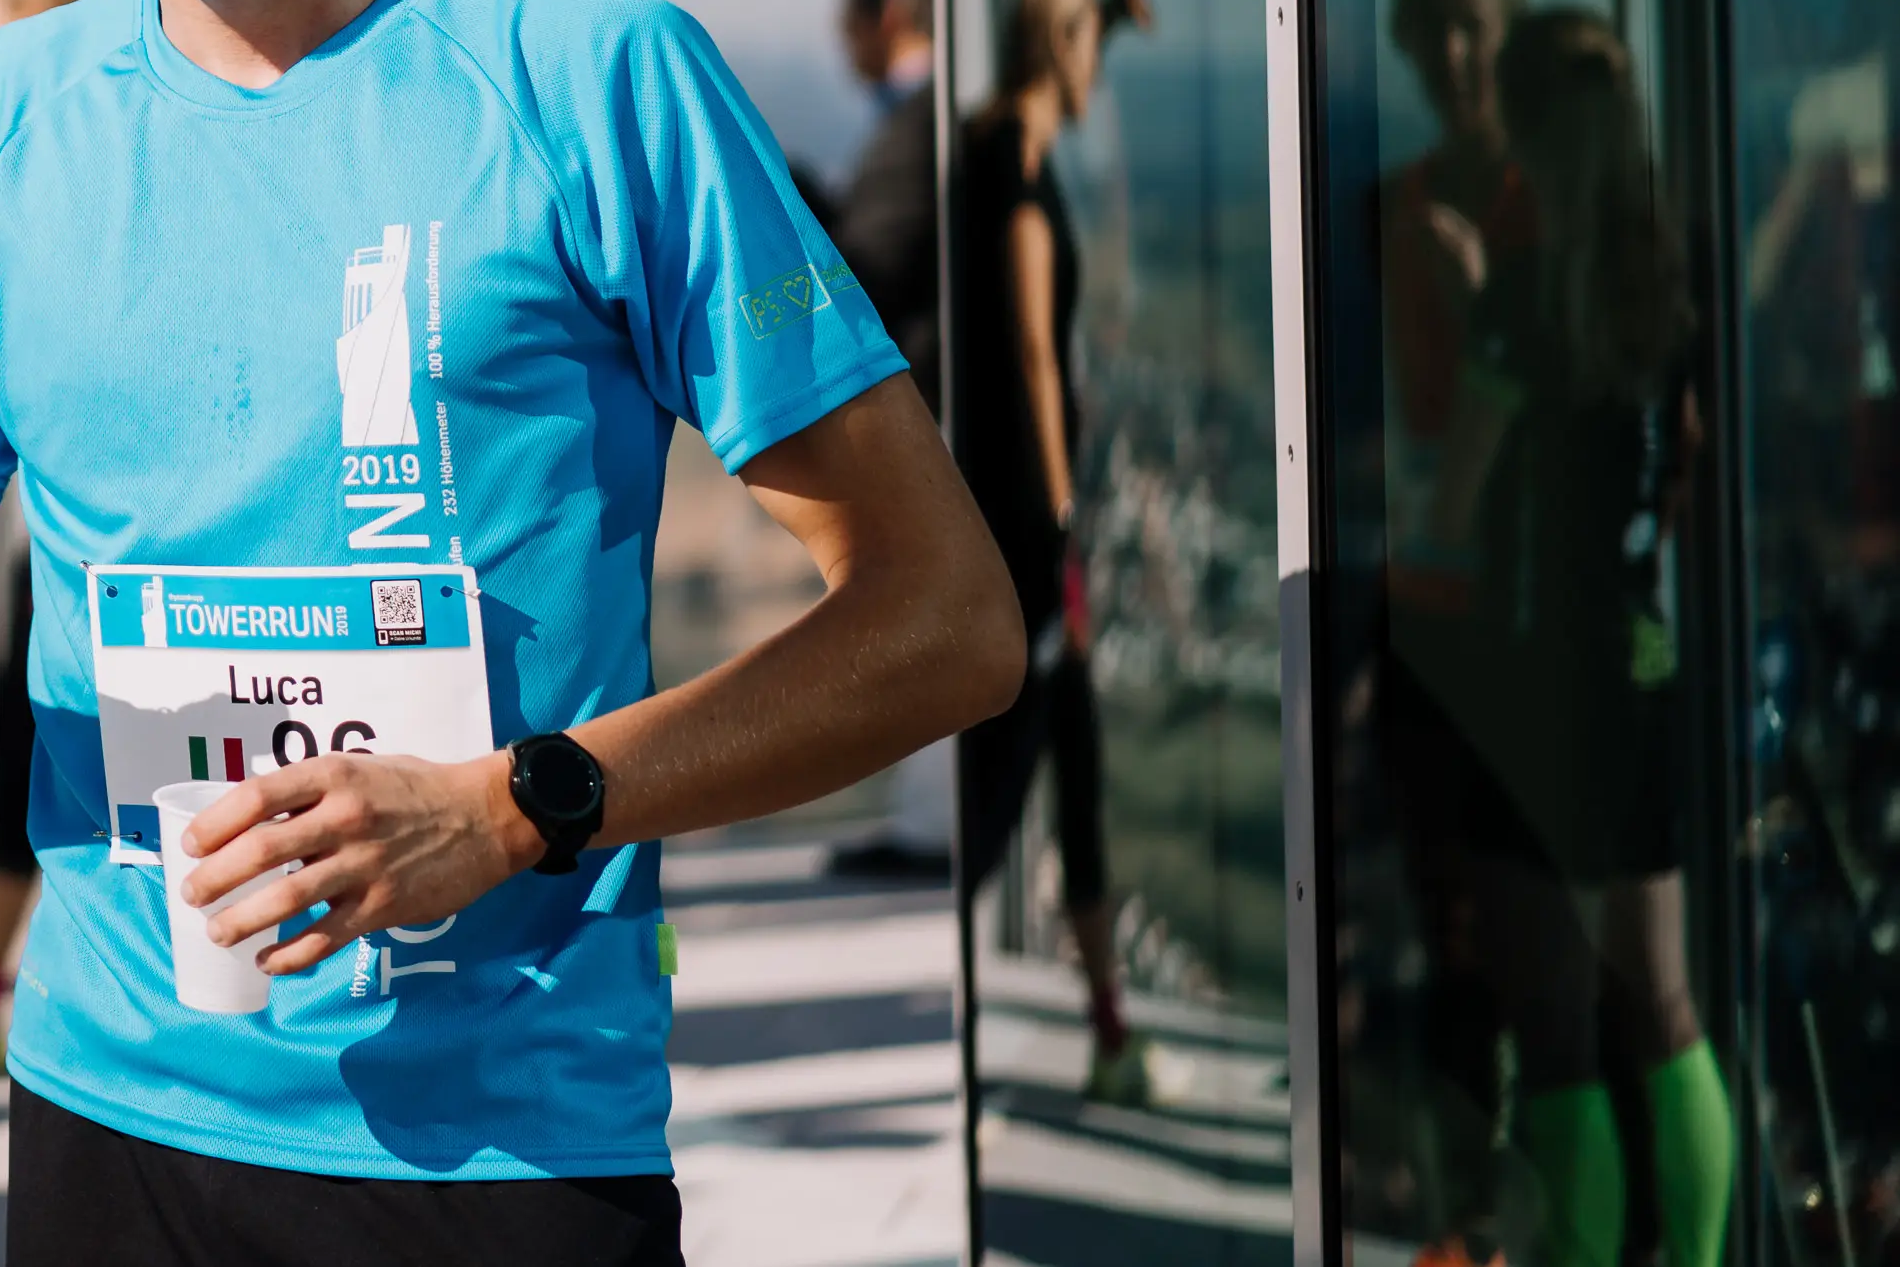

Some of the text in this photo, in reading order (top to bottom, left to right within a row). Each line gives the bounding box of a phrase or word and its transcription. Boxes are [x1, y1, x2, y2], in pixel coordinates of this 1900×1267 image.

[425, 220, 442, 331] Herausforderung
[427, 334, 442, 350] %
[428, 352, 443, 379] 100
[436, 400, 454, 484] Höhenmeter
[342, 454, 420, 486] 2019
[444, 488, 458, 516] 232
[168, 604, 349, 637] TOWERRUN 2019
[229, 665, 323, 705] Luca
